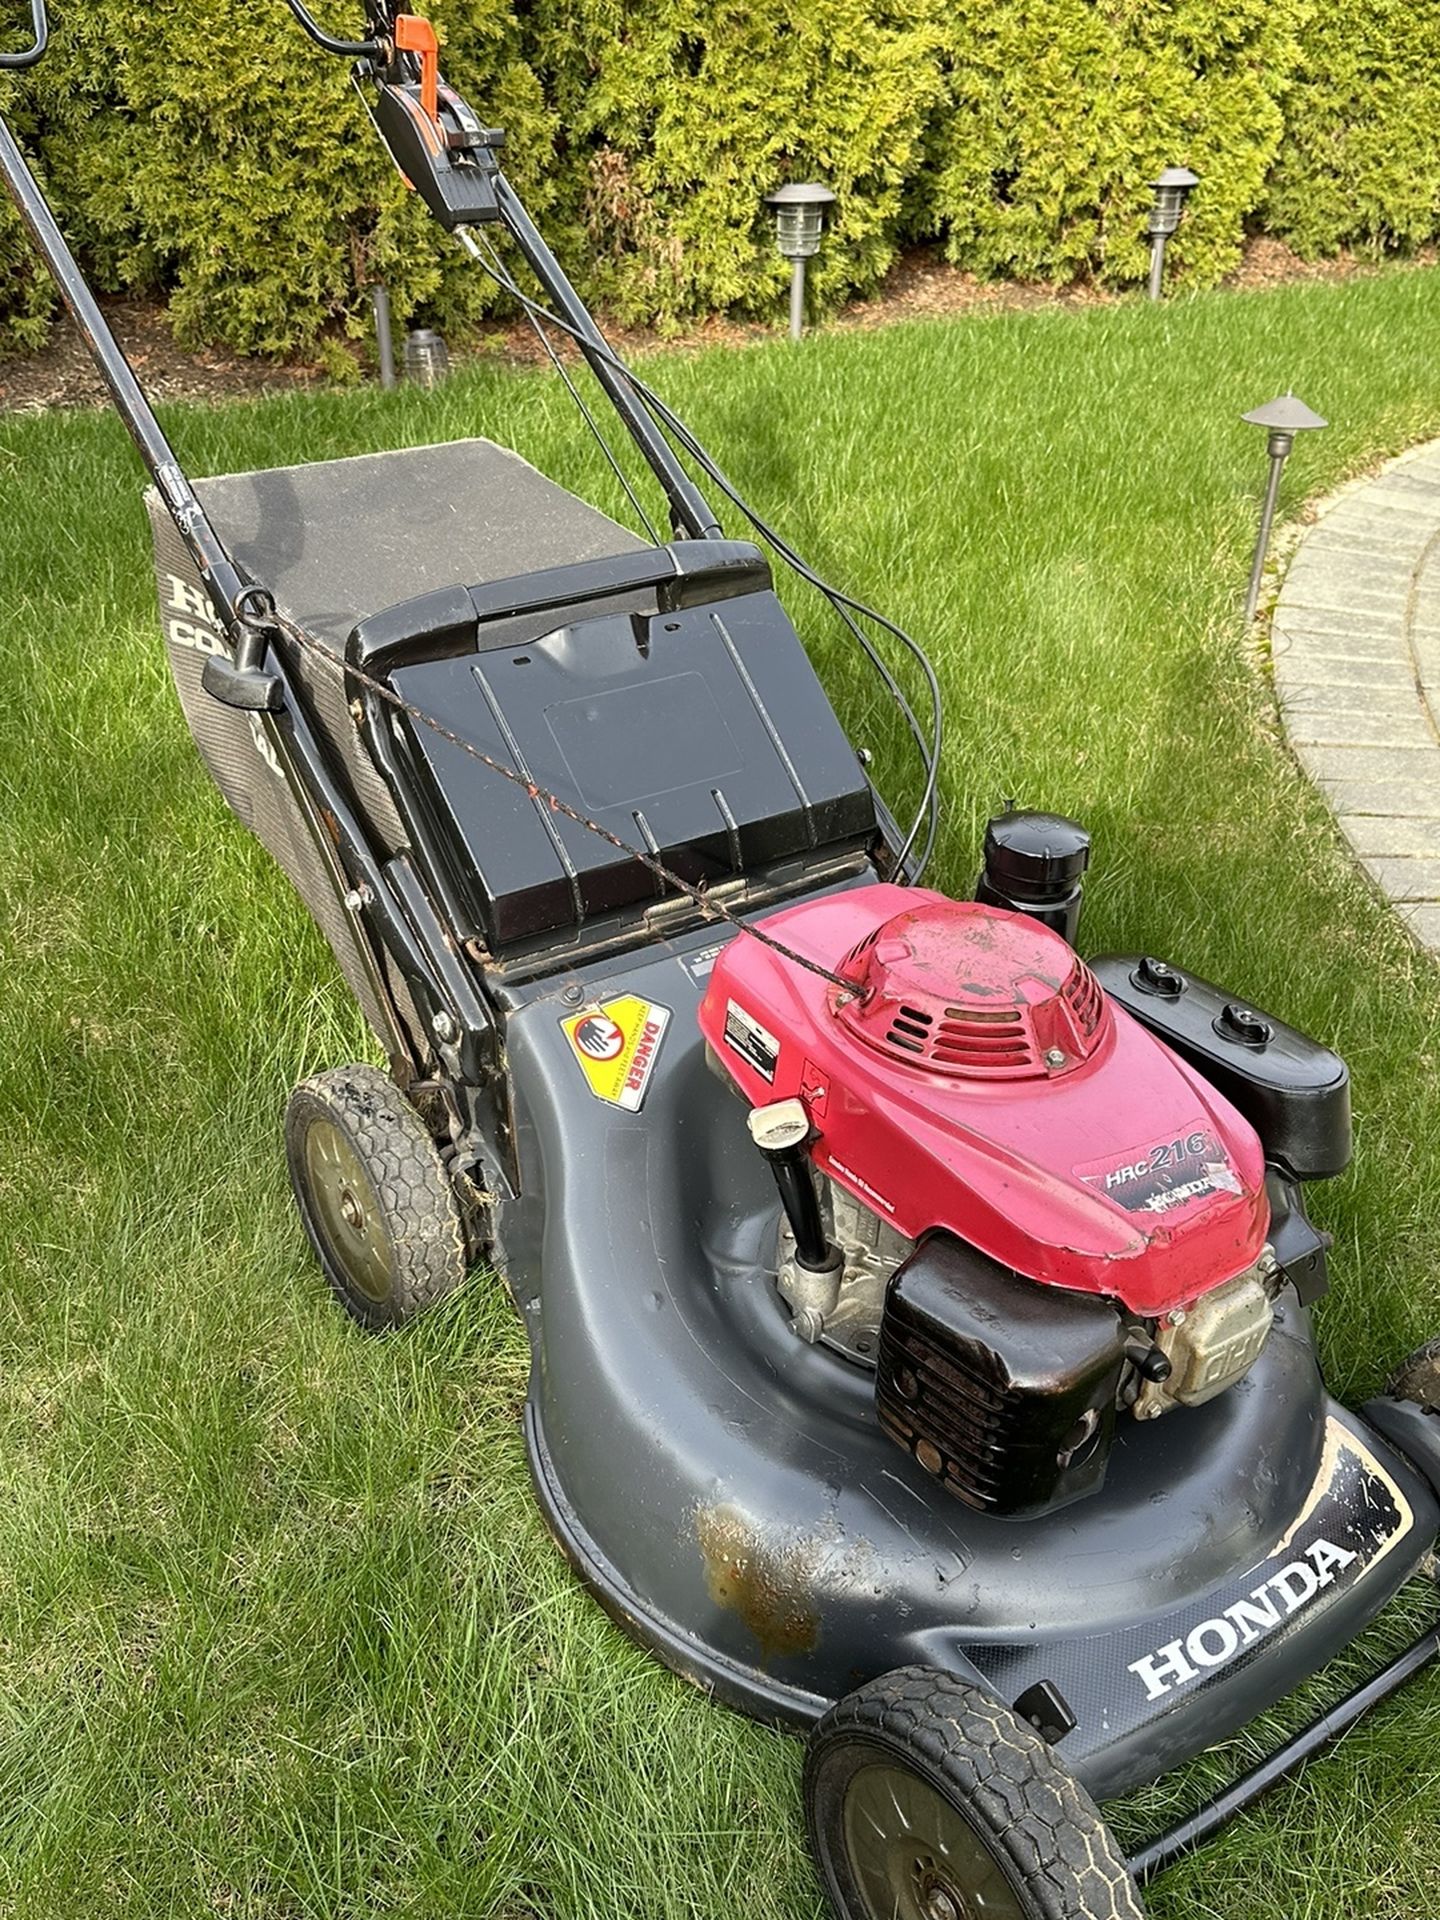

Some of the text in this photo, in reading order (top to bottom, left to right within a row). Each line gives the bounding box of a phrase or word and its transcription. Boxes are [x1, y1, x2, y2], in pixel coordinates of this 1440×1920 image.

[637, 1005, 646, 1022] KEEP
[628, 1023, 640, 1046] HANDS
[617, 1058, 629, 1076] FEET
[625, 1021, 660, 1091] DANGER
[1127, 1538, 1358, 1702] HONDA
